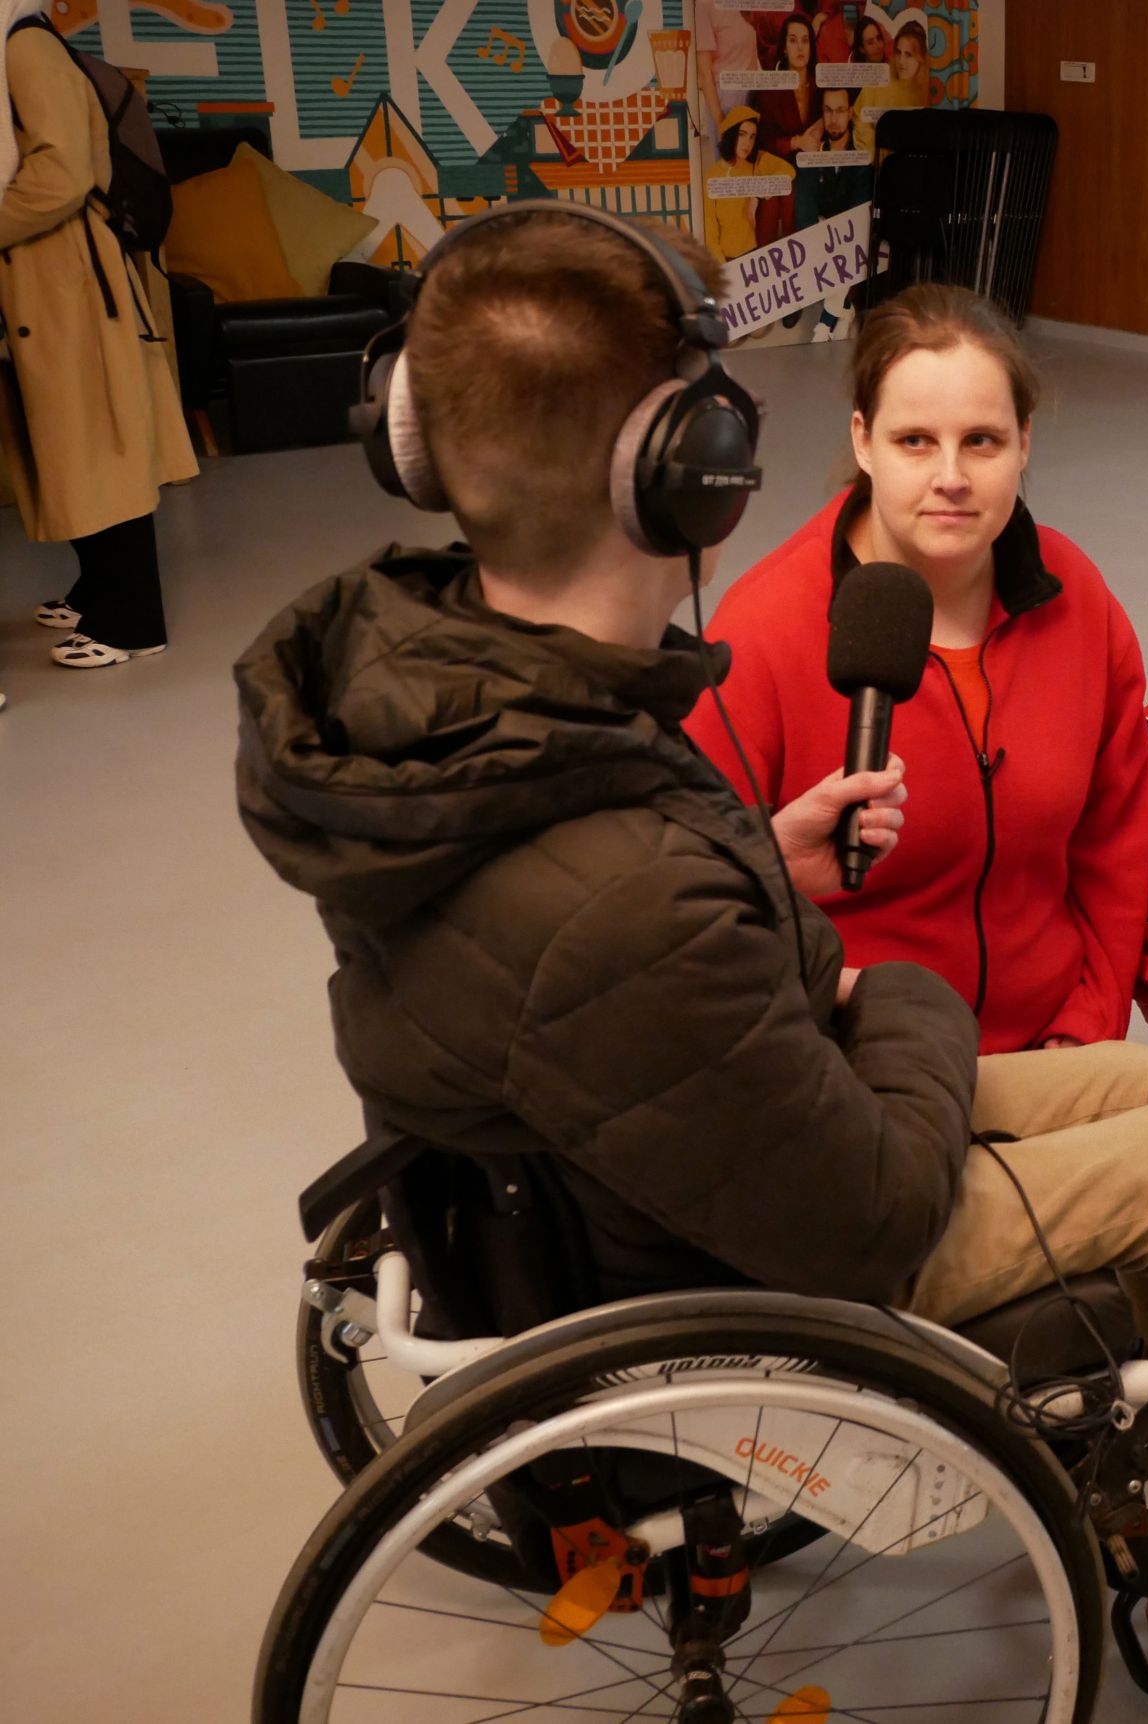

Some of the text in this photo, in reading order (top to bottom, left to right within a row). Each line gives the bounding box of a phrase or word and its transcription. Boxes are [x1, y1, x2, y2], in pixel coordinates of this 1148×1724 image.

[740, 219, 855, 288] WORD JIJ
[720, 244, 889, 329] NIEUWE KRA
[658, 1355, 761, 1374] PROTON
[735, 1436, 831, 1497] QUICKIE
